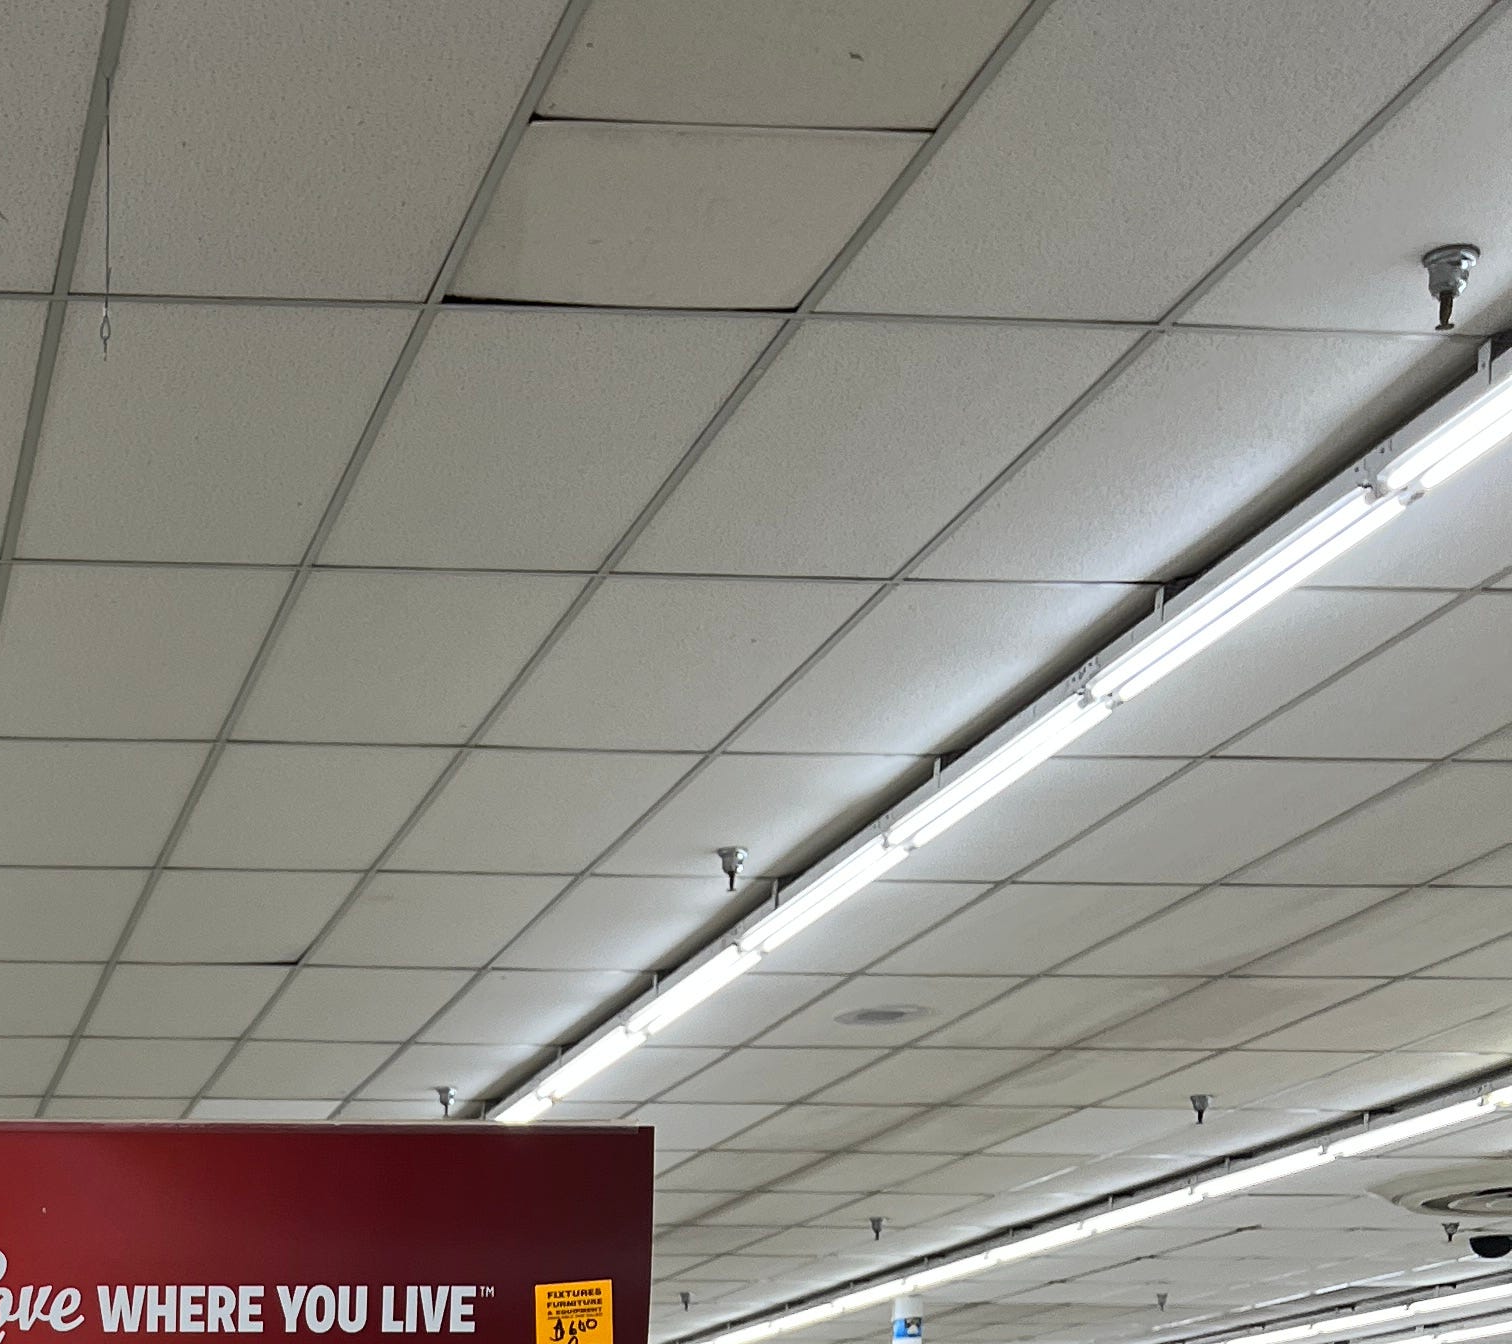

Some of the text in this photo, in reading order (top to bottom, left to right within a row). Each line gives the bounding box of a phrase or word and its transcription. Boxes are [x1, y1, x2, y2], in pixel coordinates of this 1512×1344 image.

[547, 1288, 601, 1299] FIXTURES
[547, 1298, 602, 1308] FURNITURE
[97, 1285, 265, 1333] WHERE
[276, 1284, 368, 1334] YOU
